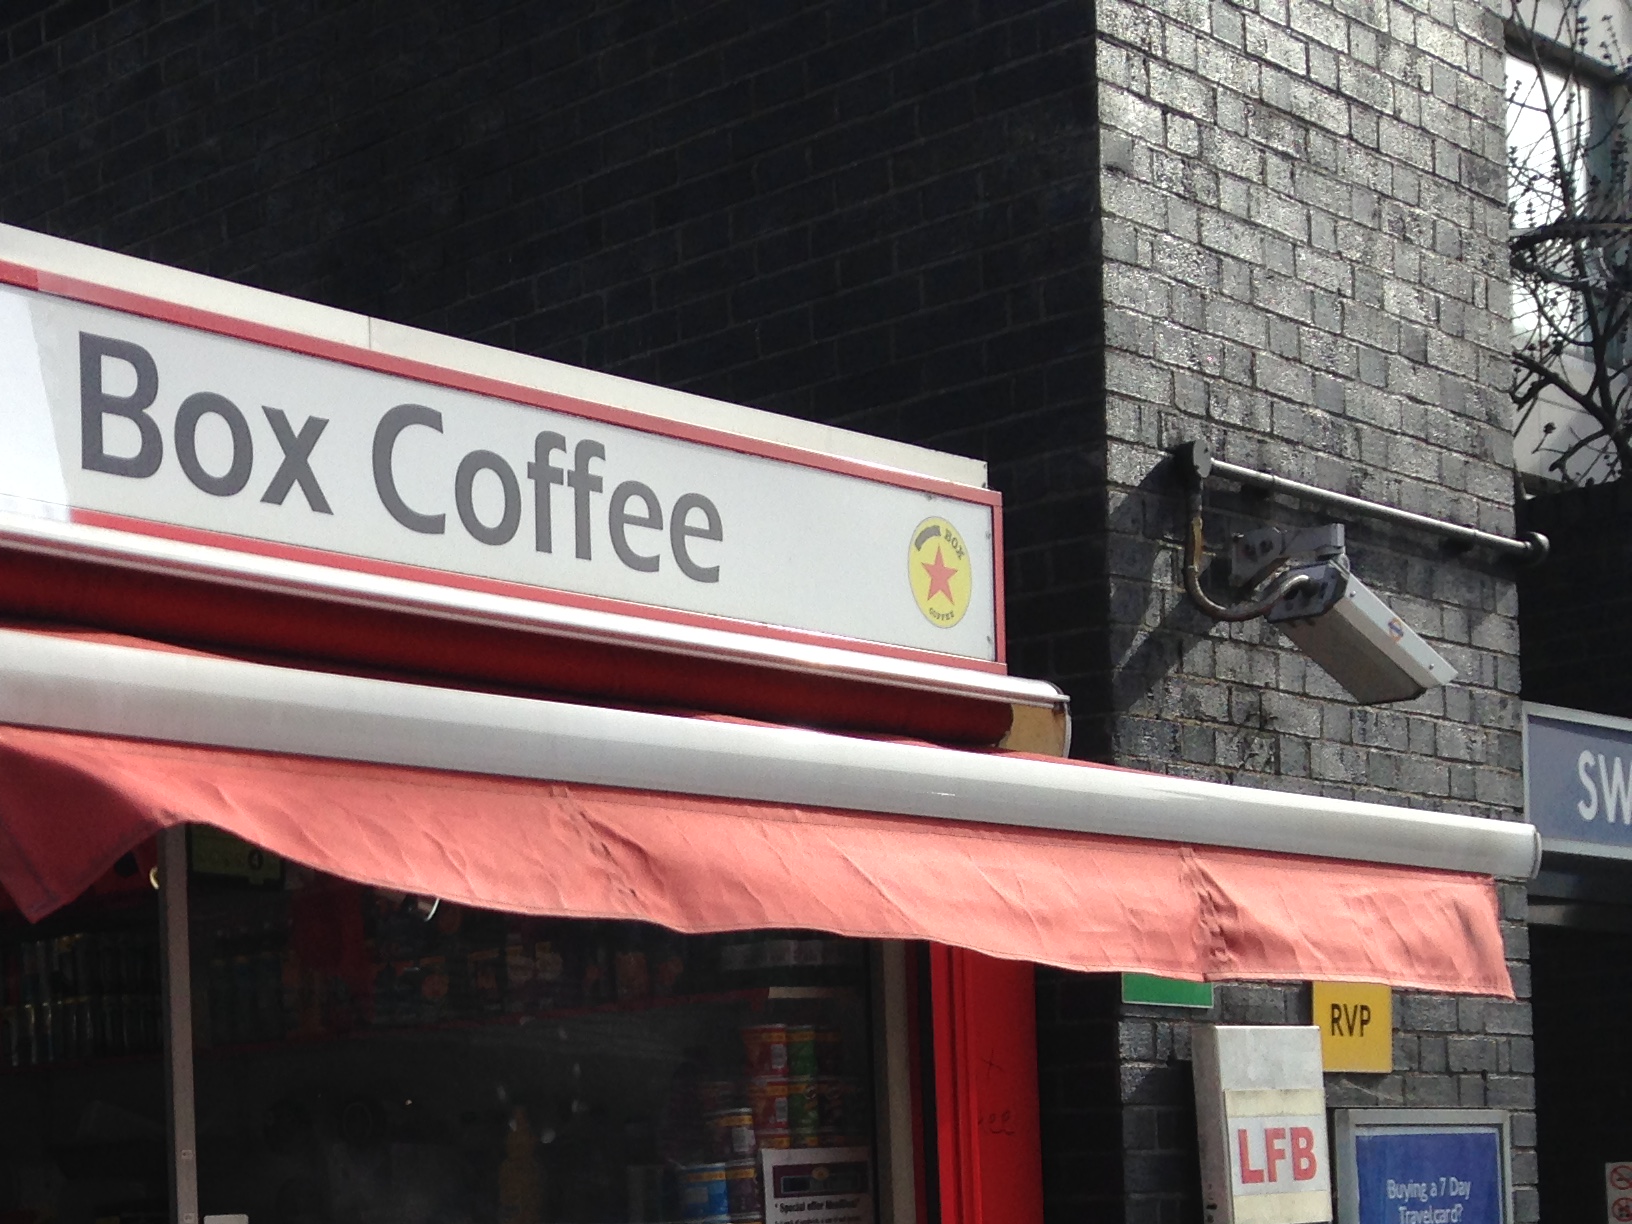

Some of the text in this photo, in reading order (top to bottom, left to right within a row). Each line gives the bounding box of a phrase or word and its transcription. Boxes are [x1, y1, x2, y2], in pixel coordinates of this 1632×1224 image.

[78, 331, 725, 584] Box Coffee
[944, 528, 966, 561] BOX
[1330, 1003, 1372, 1037] RVP
[1237, 1126, 1318, 1185] LFB
[1387, 1176, 1472, 1203] Buying a 7 Day
